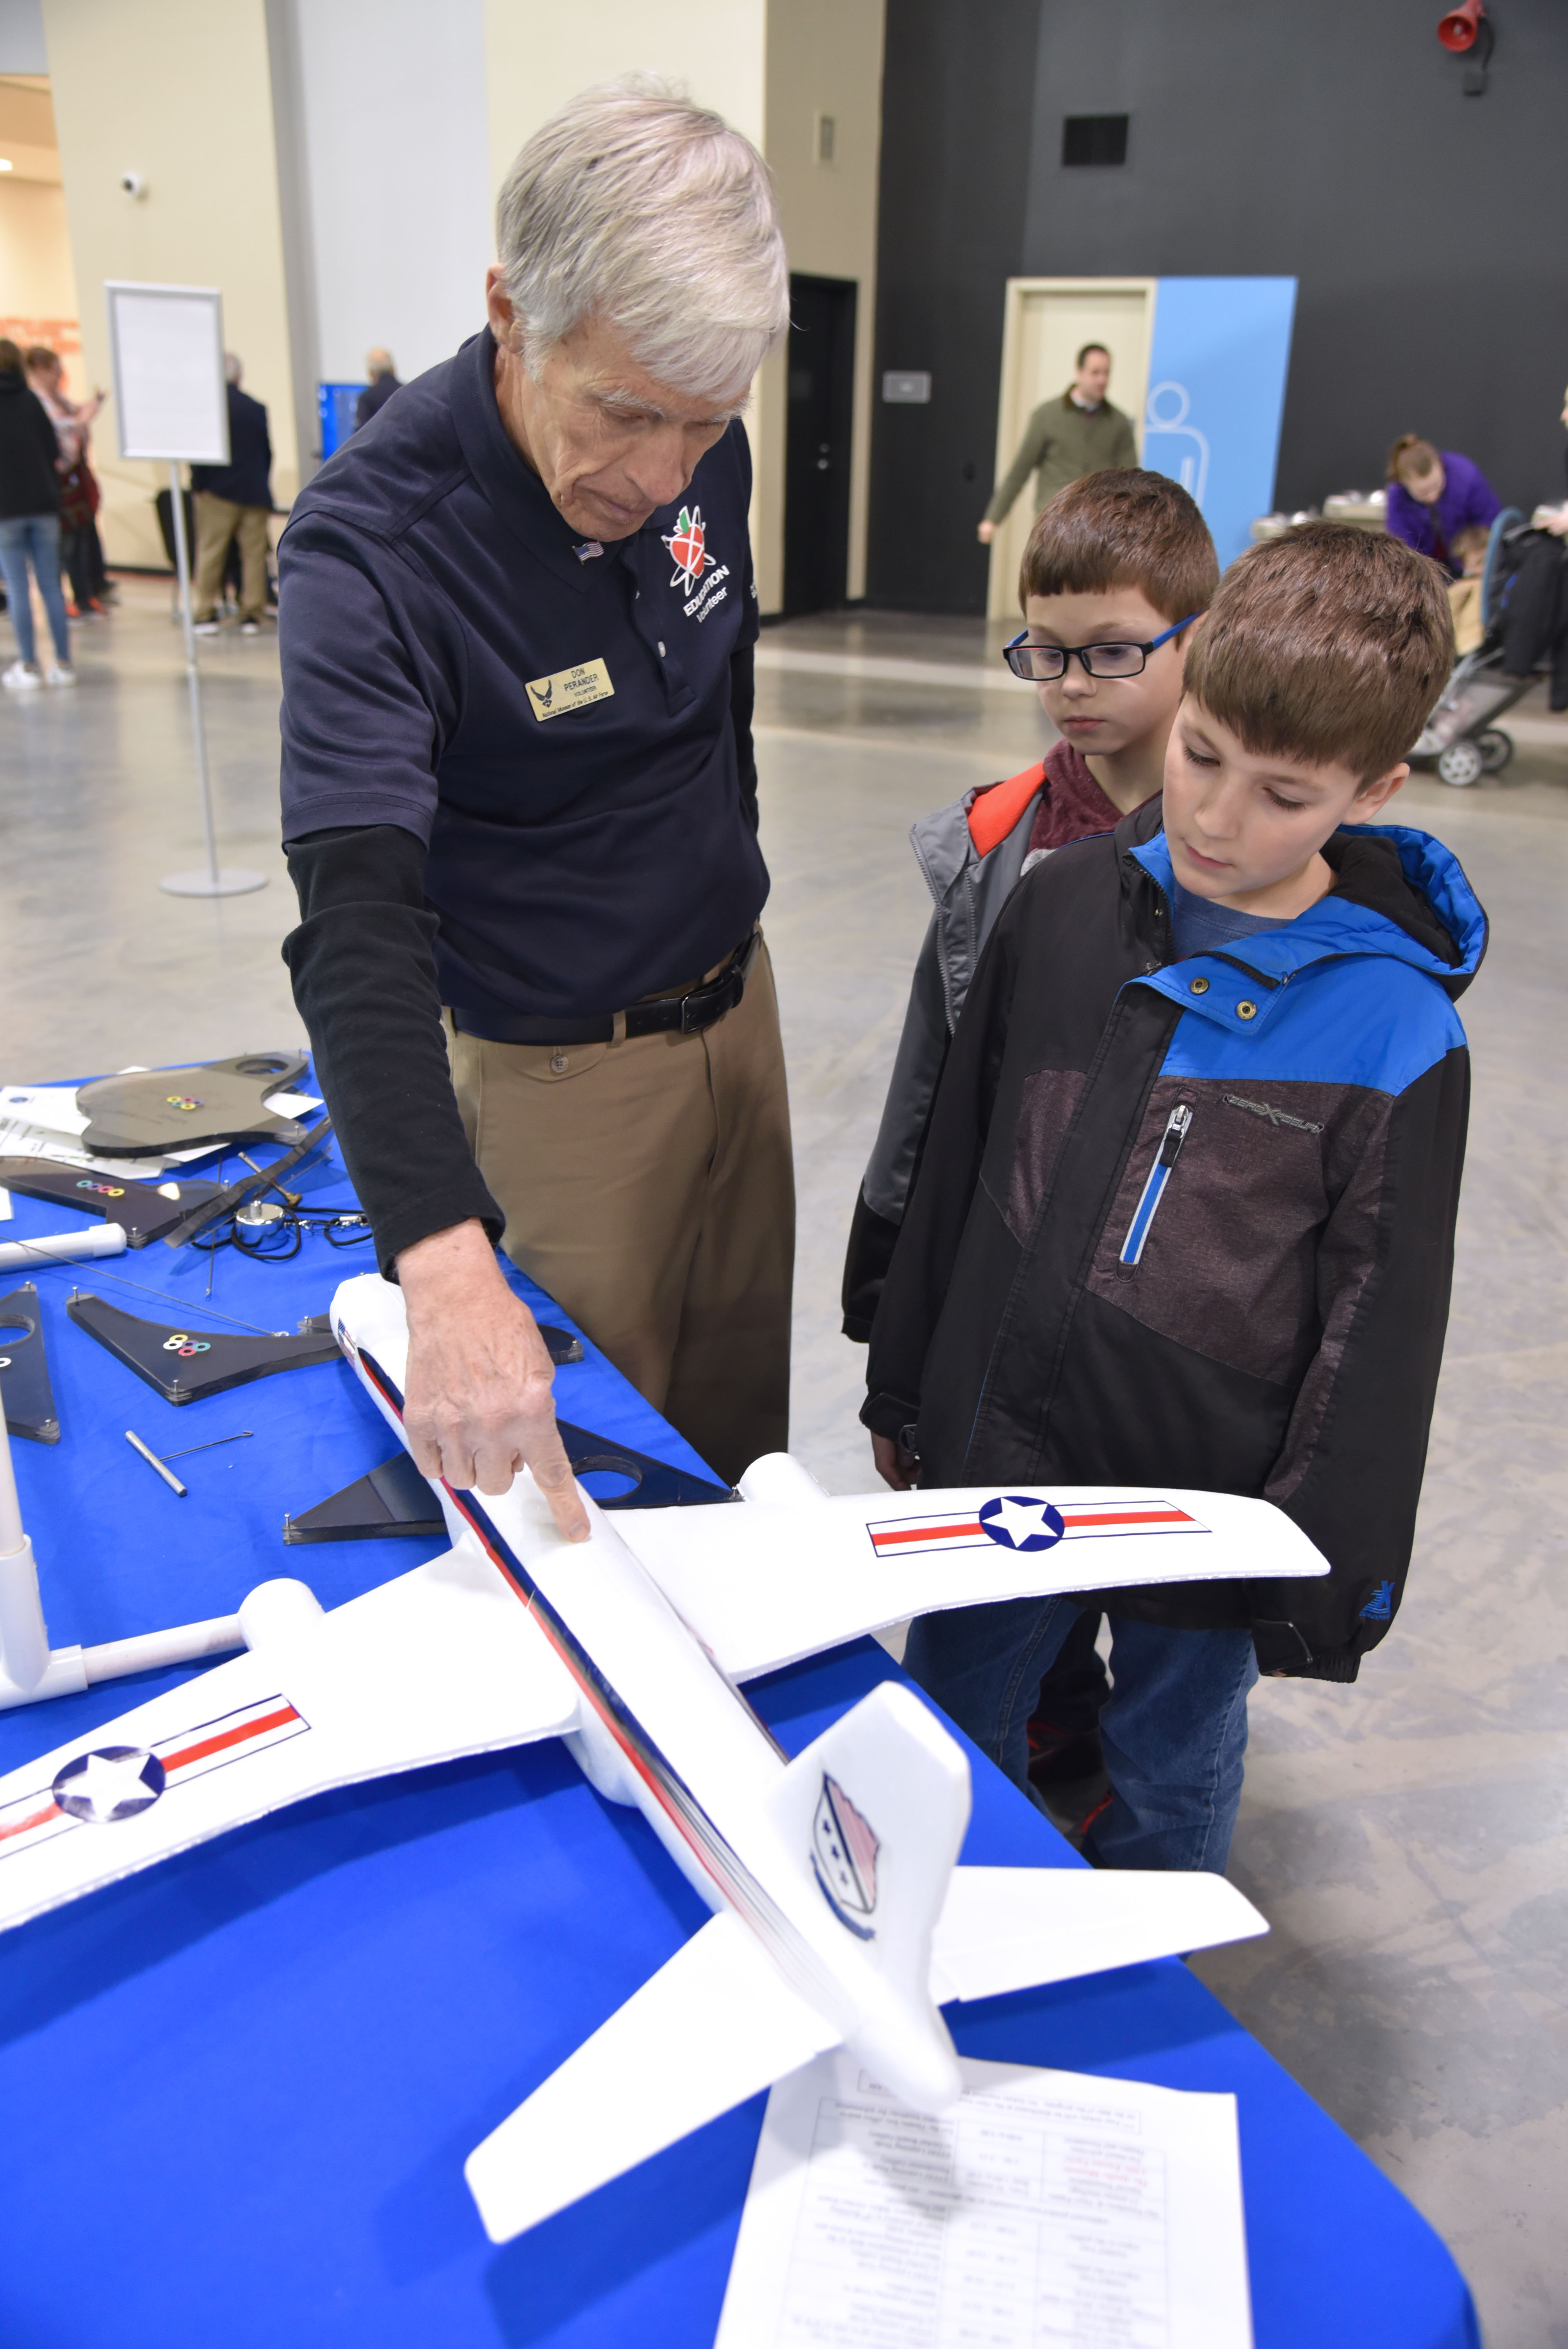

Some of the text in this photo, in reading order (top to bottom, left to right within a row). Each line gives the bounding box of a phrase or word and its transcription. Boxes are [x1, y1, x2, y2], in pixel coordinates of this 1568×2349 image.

[683, 565, 730, 617] EDUCATION
[564, 674, 599, 692] PERANDER
[571, 667, 585, 678] DON
[1229, 1095, 1319, 1133] ZEROXPOSUR
